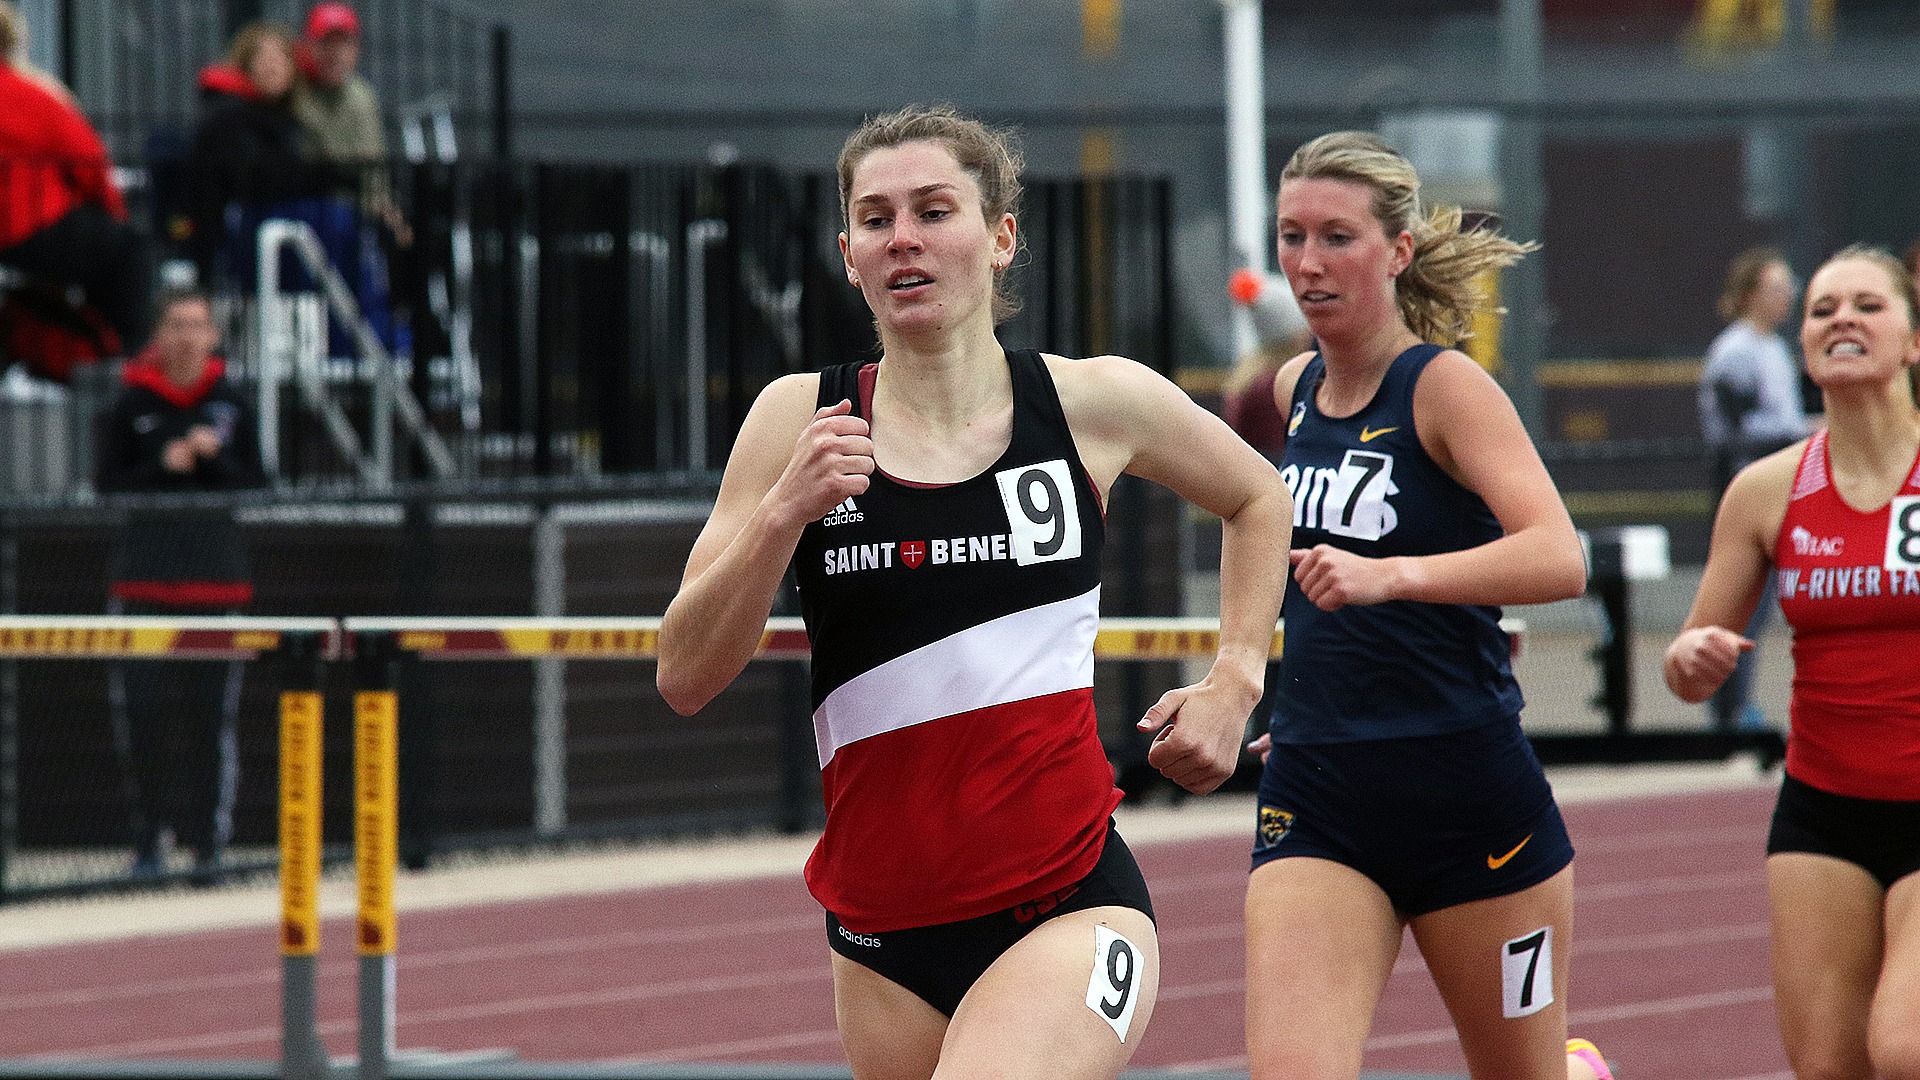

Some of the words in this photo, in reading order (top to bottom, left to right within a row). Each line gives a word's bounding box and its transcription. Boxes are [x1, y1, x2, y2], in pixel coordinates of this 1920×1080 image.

[823, 511, 864, 527] adidas
[1017, 469, 1066, 557] 9
[1341, 455, 1386, 527] 7
[824, 542, 896, 576] SAINT
[1898, 502, 1920, 565] 8
[838, 925, 882, 948] adidas
[1508, 930, 1547, 1008] 7
[1100, 939, 1134, 1020] 9
